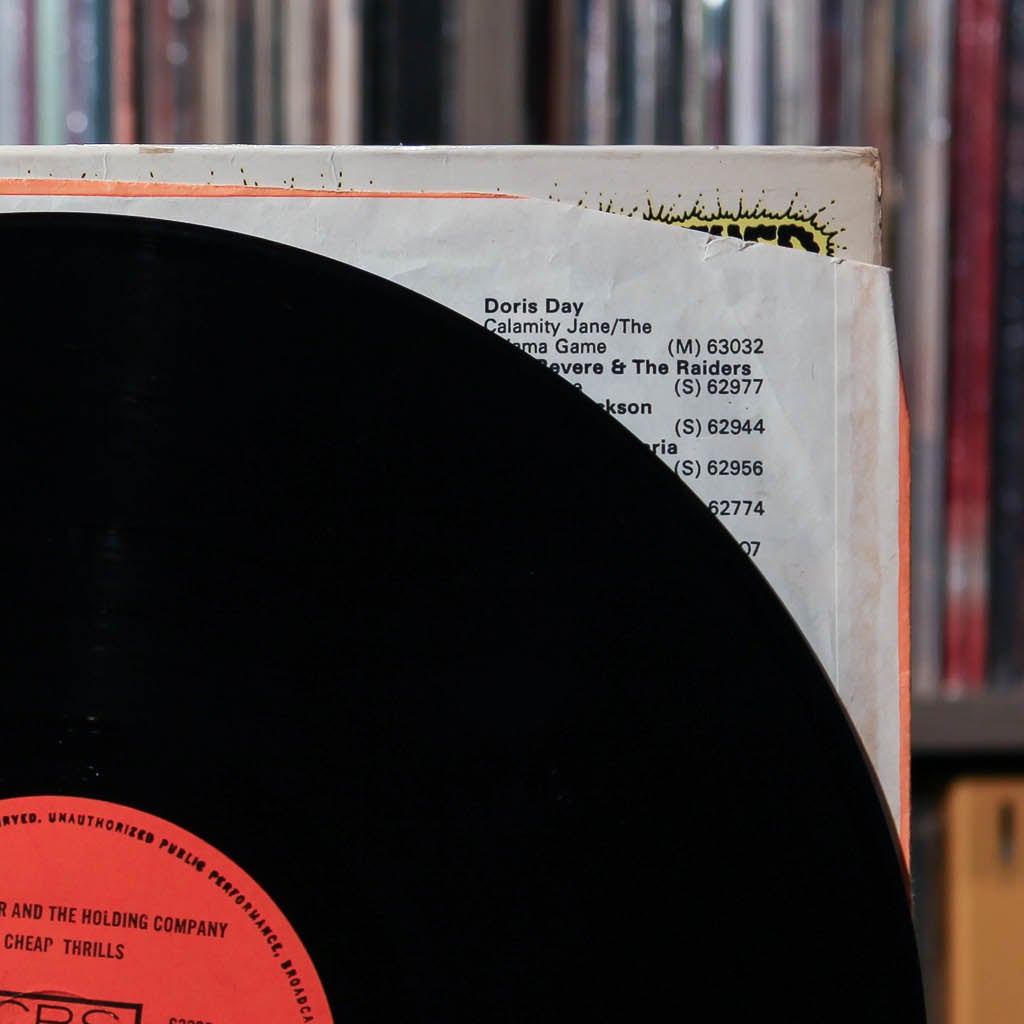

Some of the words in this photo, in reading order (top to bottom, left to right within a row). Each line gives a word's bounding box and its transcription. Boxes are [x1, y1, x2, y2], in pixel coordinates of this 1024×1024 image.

[484, 298, 538, 314] Doris
[546, 298, 584, 317] Day
[484, 318, 560, 336] Calamity
[567, 318, 652, 336] Jane/The
[555, 338, 607, 354] Game
[668, 338, 701, 357] (M)
[707, 338, 764, 354] 63032
[611, 359, 626, 375] &
[632, 359, 669, 375] The
[676, 359, 752, 375] Raiders
[675, 379, 701, 397] (S)
[707, 379, 764, 394] 62977
[675, 418, 702, 437] (S)
[707, 419, 765, 434] 62944
[707, 460, 763, 476] 62956
[708, 501, 765, 516] 62774
[48, 812, 154, 844] UNAUTHORIZED
[159, 838, 206, 872] PUBLIC
[208, 870, 283, 957] PERFORMANCE,
[11, 903, 43, 920] AND
[49, 906, 77, 923] THE
[82, 909, 149, 930] HOLDING
[153, 915, 228, 938] COMPANY
[4, 934, 53, 952] CHEAP
[64, 939, 125, 960] THRILLS
